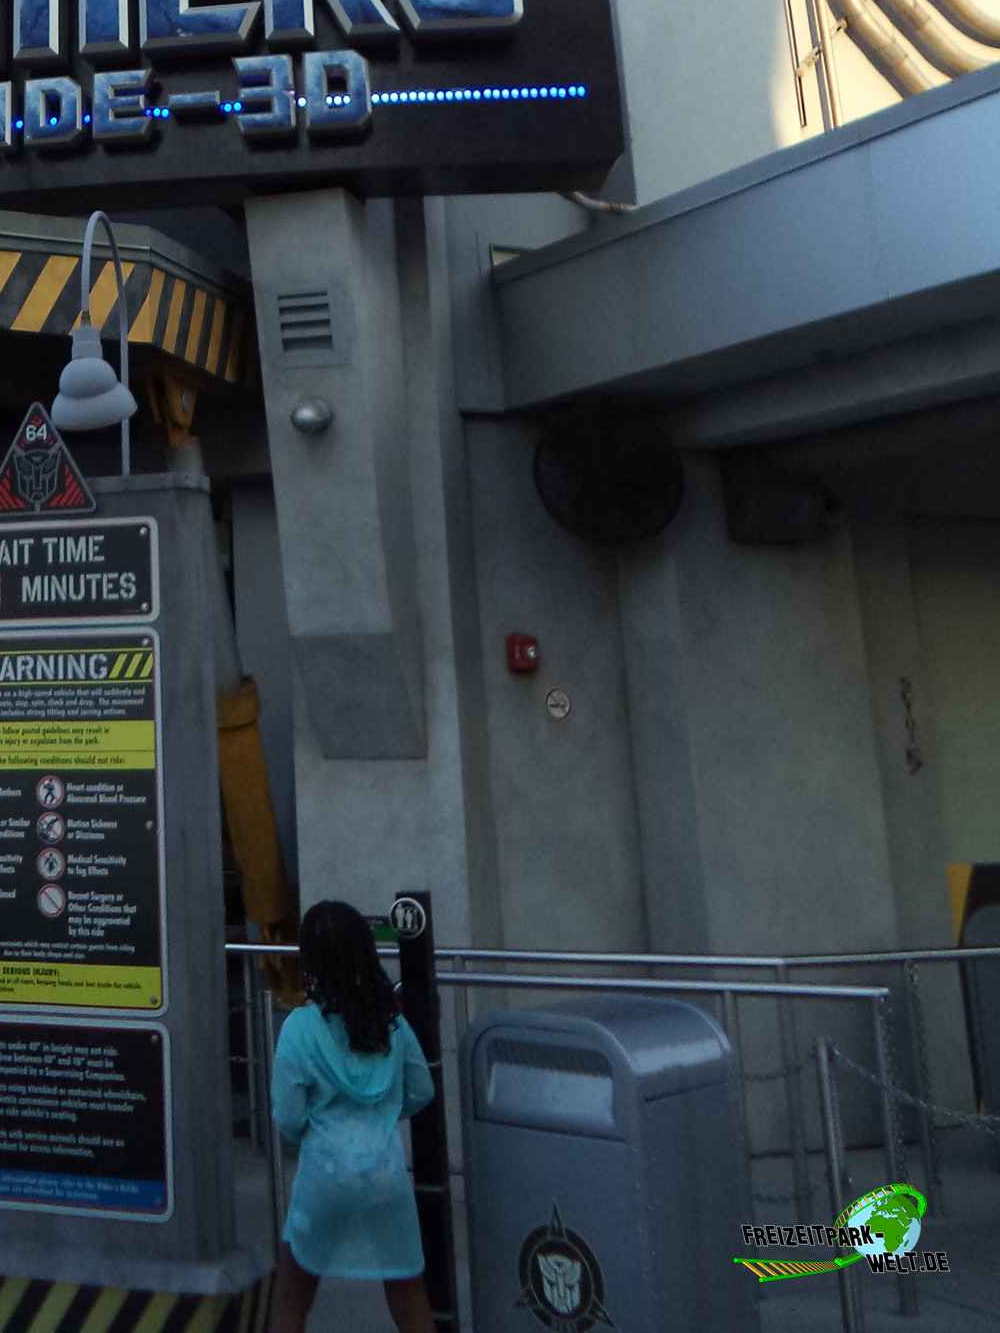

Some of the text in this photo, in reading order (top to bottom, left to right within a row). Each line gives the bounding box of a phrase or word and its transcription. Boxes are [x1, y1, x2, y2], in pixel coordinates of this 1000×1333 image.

[25, 423, 47, 441] 64
[42, 535, 105, 563] TIME
[21, 572, 136, 603] MINUTES
